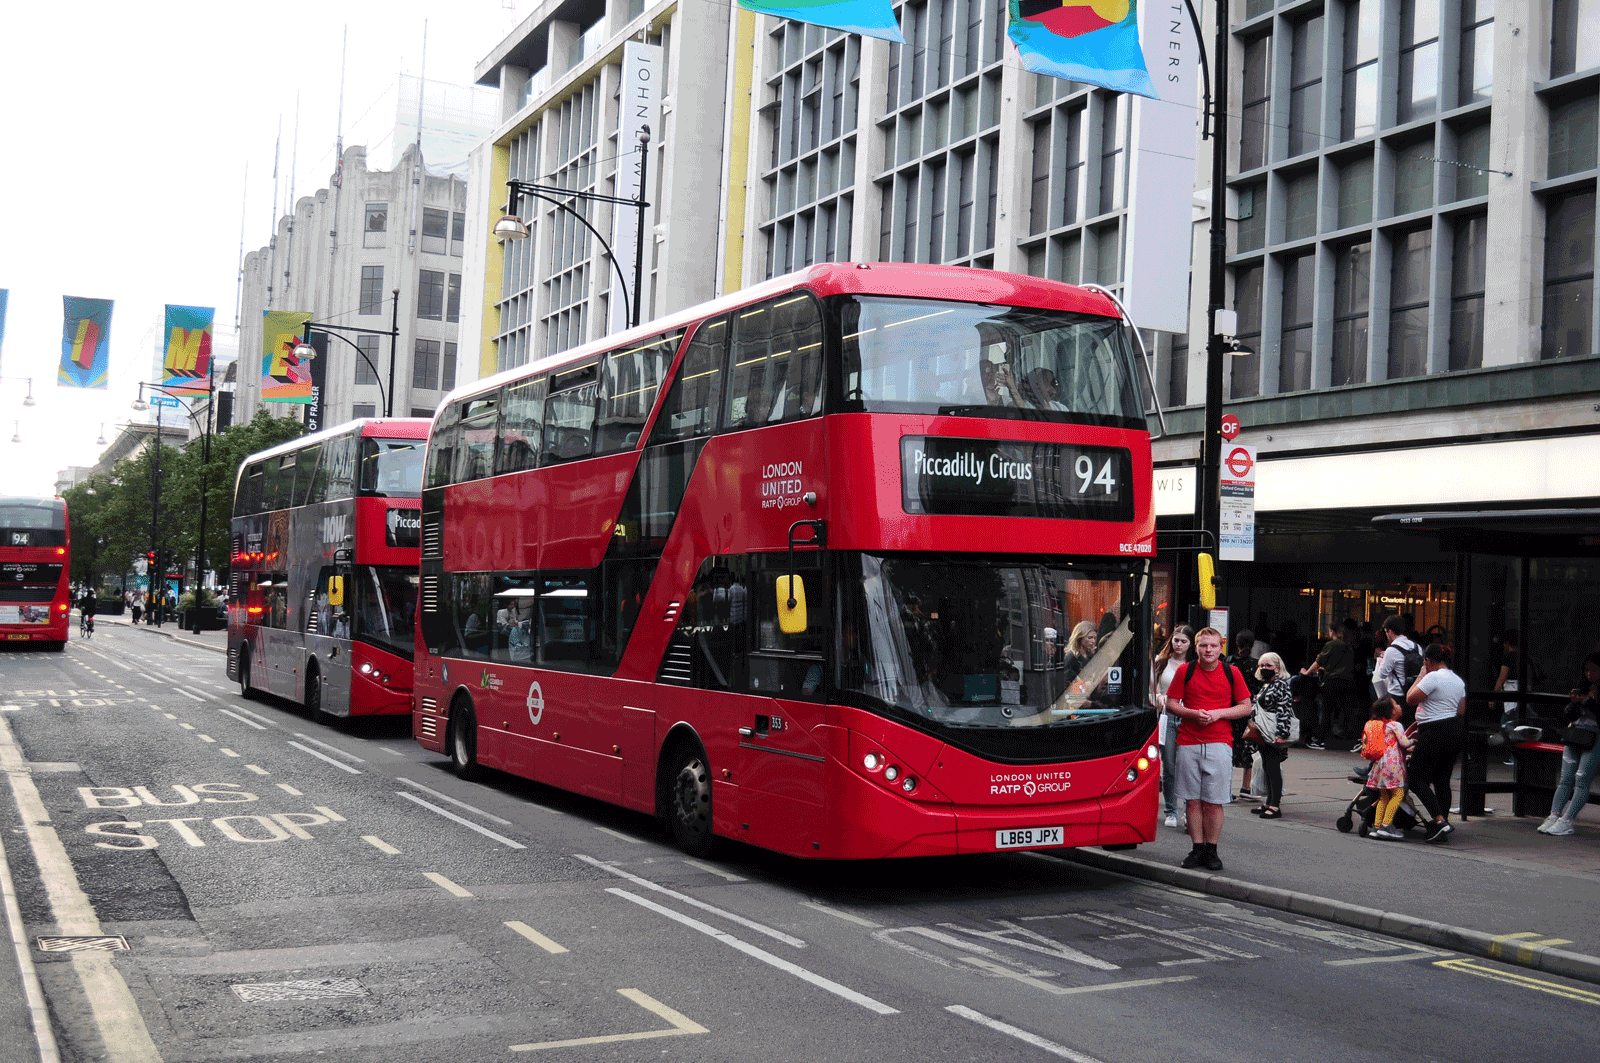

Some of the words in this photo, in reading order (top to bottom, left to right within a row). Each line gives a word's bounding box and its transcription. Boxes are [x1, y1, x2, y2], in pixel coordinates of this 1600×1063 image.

[636, 56, 651, 119] JOHN
[310, 385, 320, 414] FRASER
[309, 416, 317, 431] OF
[1221, 422, 1238, 434] OF
[762, 461, 802, 479] LONDON
[914, 449, 985, 485] Piccadilly
[989, 453, 1032, 480] Circus
[1074, 455, 1116, 495] 94
[762, 479, 802, 497] UNITED
[761, 499, 777, 509] RATP
[783, 497, 802, 507] GROUP
[14, 533, 29, 545] 94
[1119, 543, 1132, 552] BCE
[1132, 543, 1152, 553] 47020
[990, 773, 1032, 782] LONDON
[1036, 771, 1072, 780] UNITED
[77, 783, 260, 809] BUS
[990, 784, 1021, 795] RATP
[1037, 782, 1071, 793] GROUP
[85, 812, 332, 850] STOP
[1001, 830, 1032, 846] LB69
[1036, 828, 1059, 843] JPX
